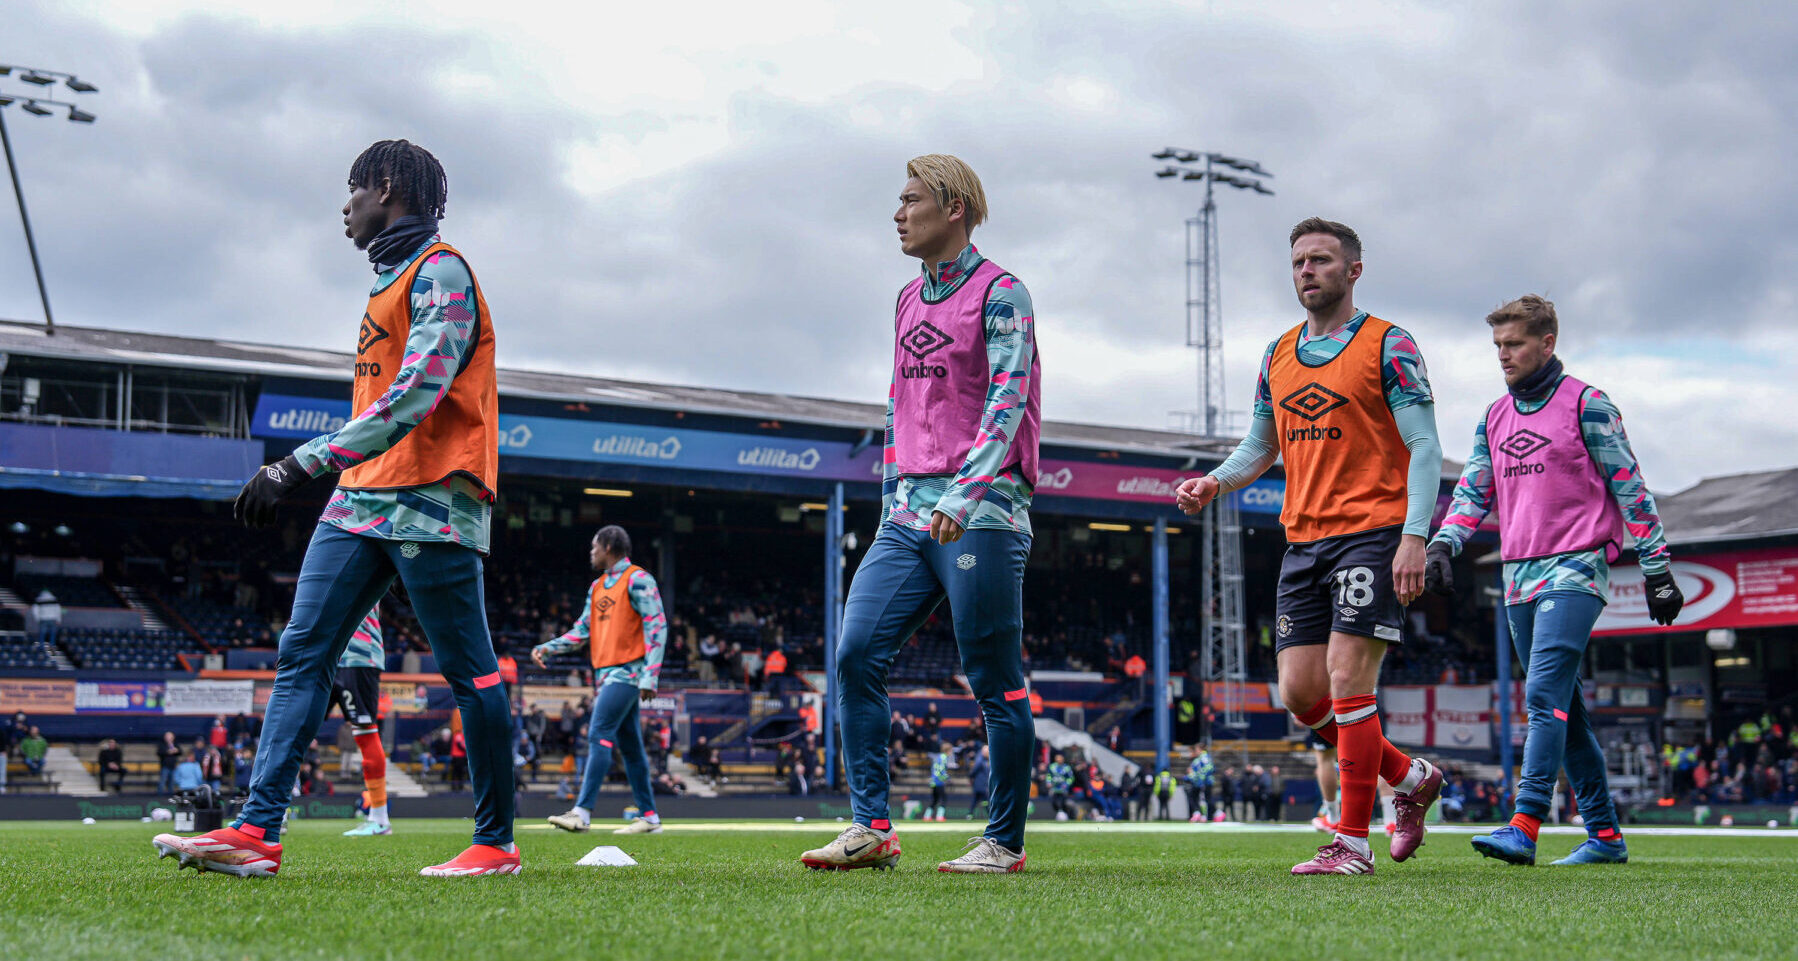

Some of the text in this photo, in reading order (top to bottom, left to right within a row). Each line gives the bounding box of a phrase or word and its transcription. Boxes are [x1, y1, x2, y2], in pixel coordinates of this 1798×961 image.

[355, 361, 381, 377] mbro
[901, 361, 947, 379] umbro
[269, 409, 345, 432] utilita
[1287, 424, 1342, 441] umbro
[592, 435, 658, 458] utilita
[737, 447, 799, 469] utilita
[1117, 476, 1170, 496] utilita
[1336, 566, 1375, 606] 18
[342, 689, 356, 710] 2
